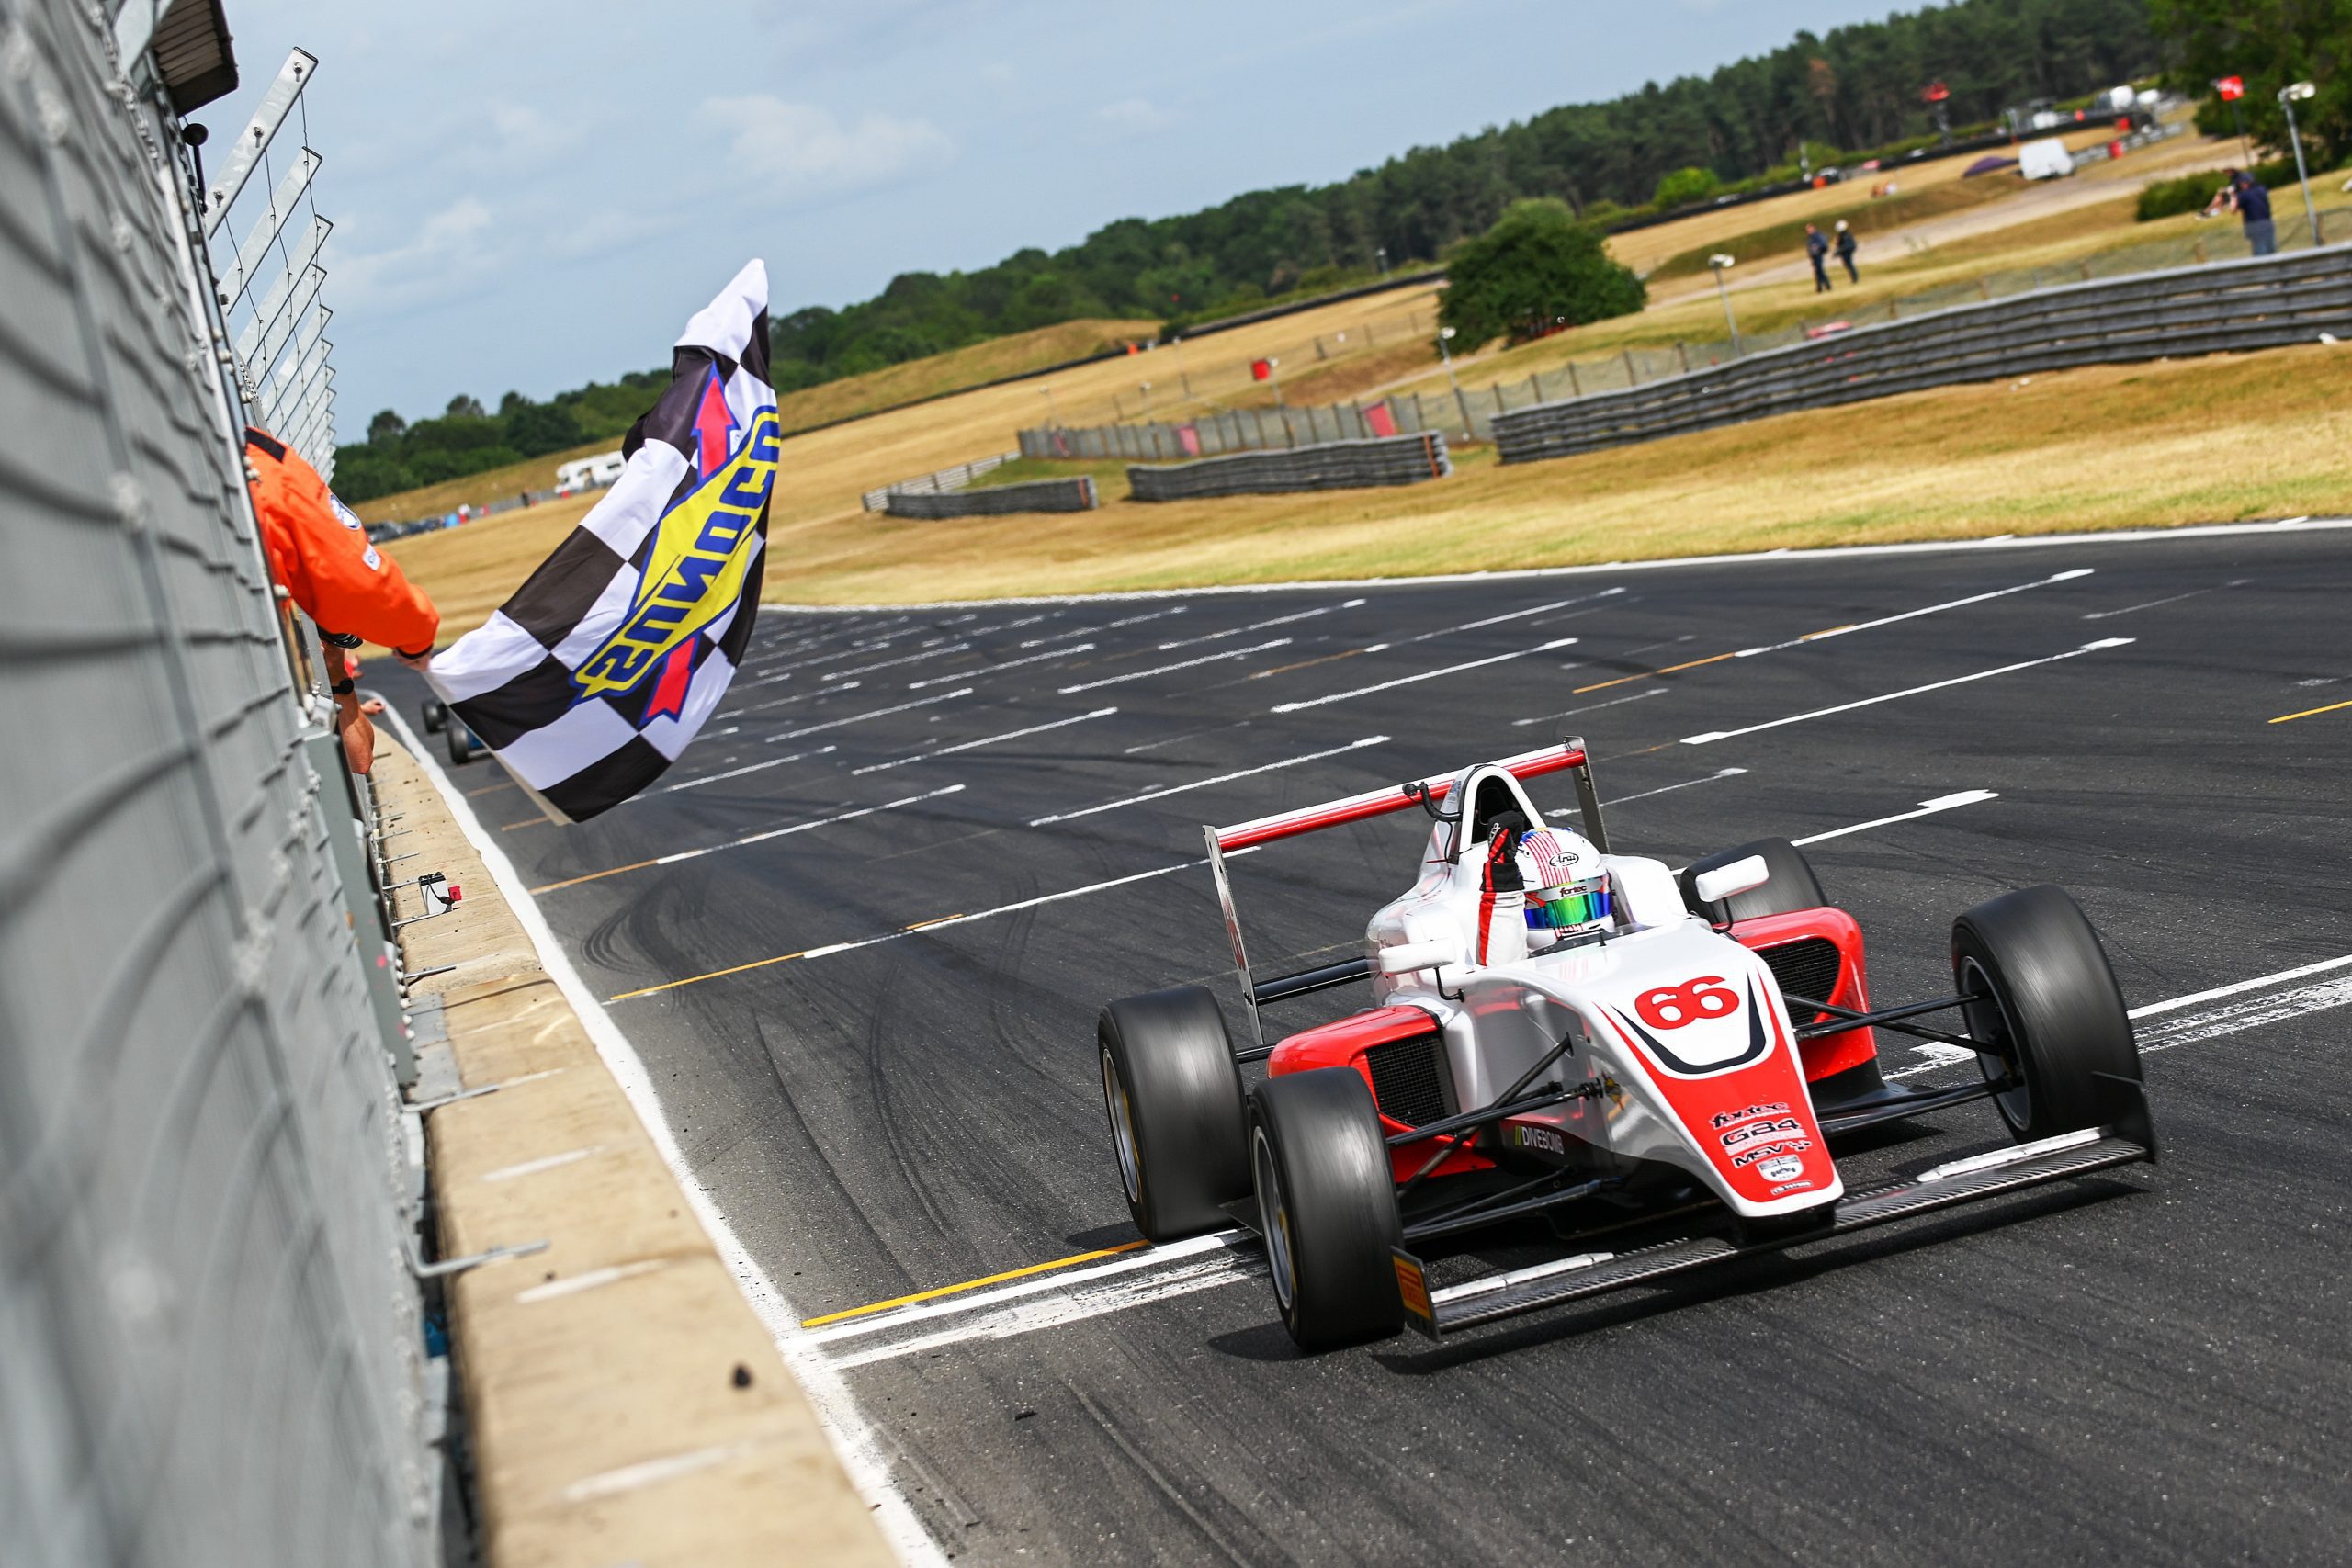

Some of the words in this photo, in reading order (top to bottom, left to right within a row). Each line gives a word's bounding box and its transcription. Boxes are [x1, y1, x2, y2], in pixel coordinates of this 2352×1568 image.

[1559, 886, 1588, 897] fortec
[1634, 976, 1740, 1030] 66
[1521, 1126, 1565, 1155] DIVEBOMB
[1722, 1118, 1801, 1146] GB4
[1733, 1144, 1784, 1167] MSV
